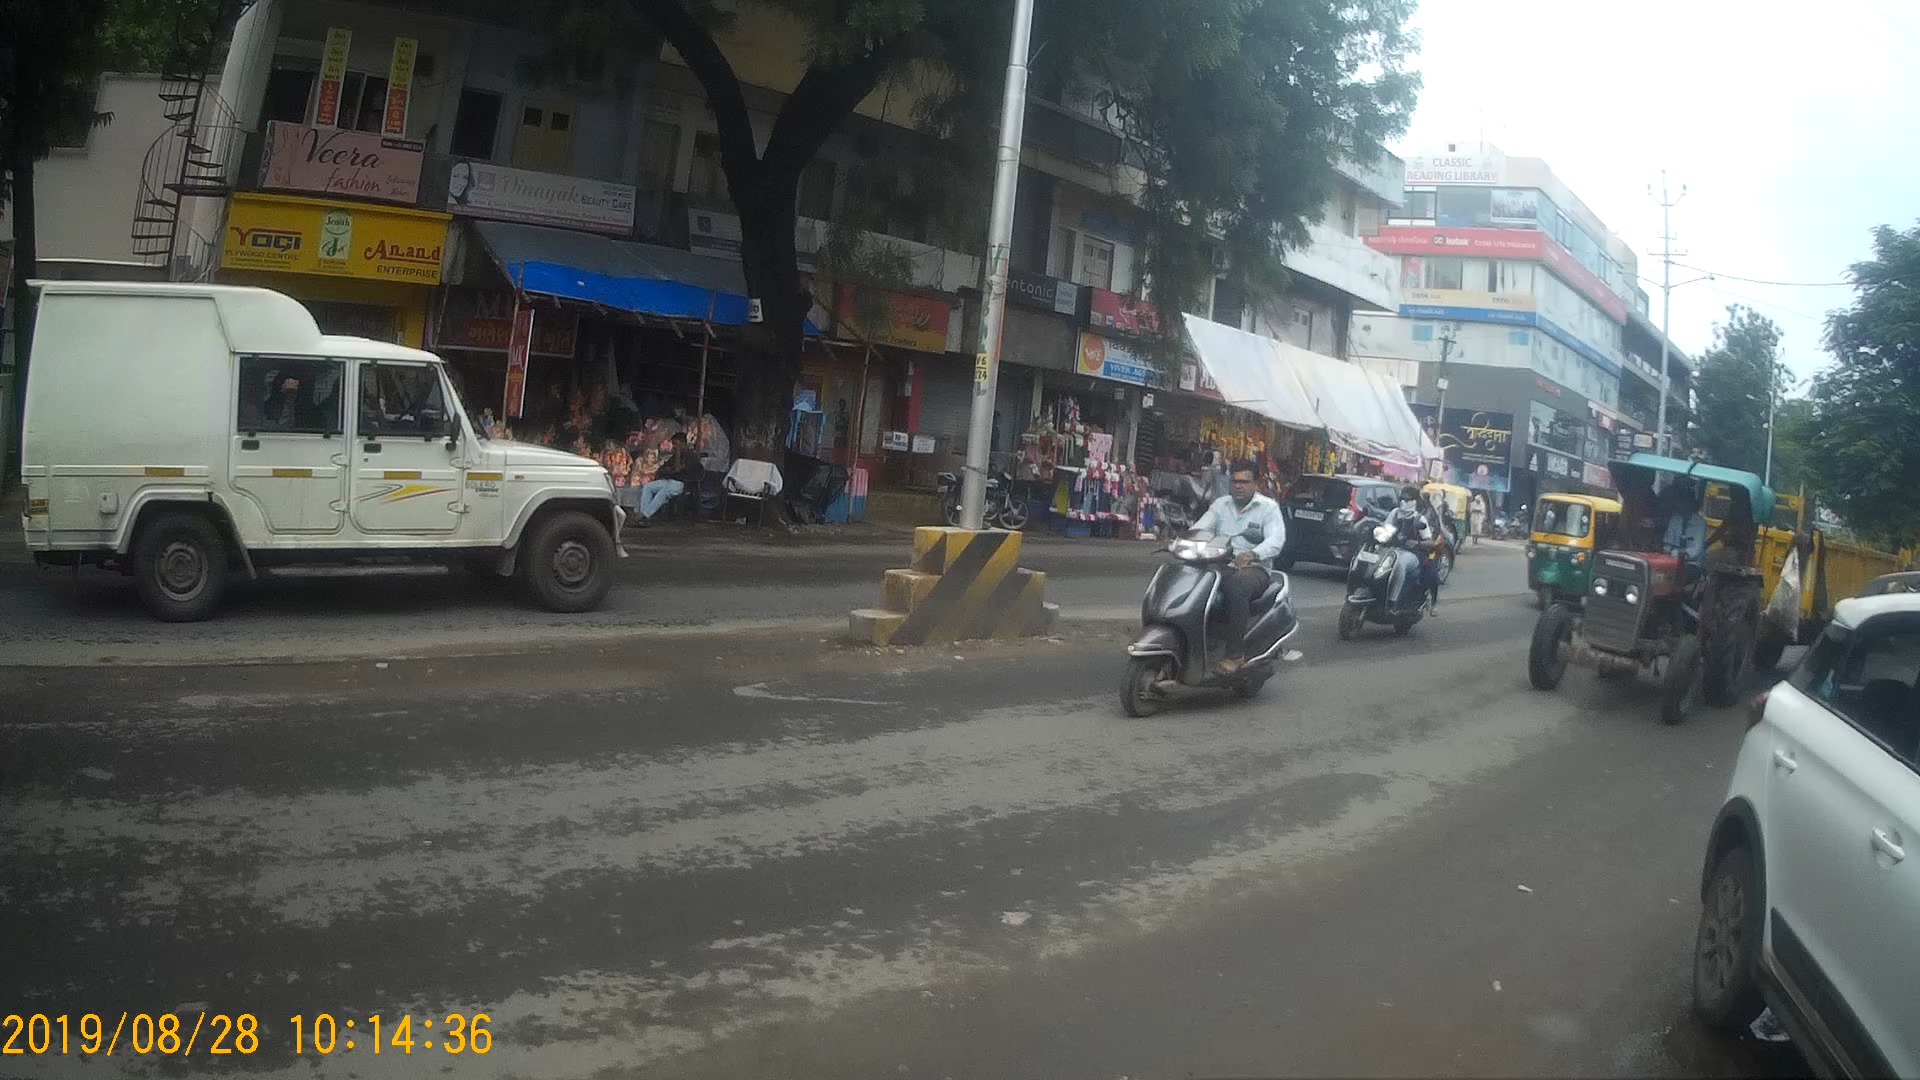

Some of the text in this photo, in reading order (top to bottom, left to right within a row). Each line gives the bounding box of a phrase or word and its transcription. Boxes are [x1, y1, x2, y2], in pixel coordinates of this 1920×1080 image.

[301, 129, 382, 168] Veera
[1432, 157, 1473, 168] CLASSIC
[325, 168, 381, 192] fashion
[1406, 171, 1497, 182] READING LIBRARY
[230, 226, 302, 252] YOGI
[363, 239, 440, 265] Anand
[377, 264, 438, 279] ENTERPRISE
